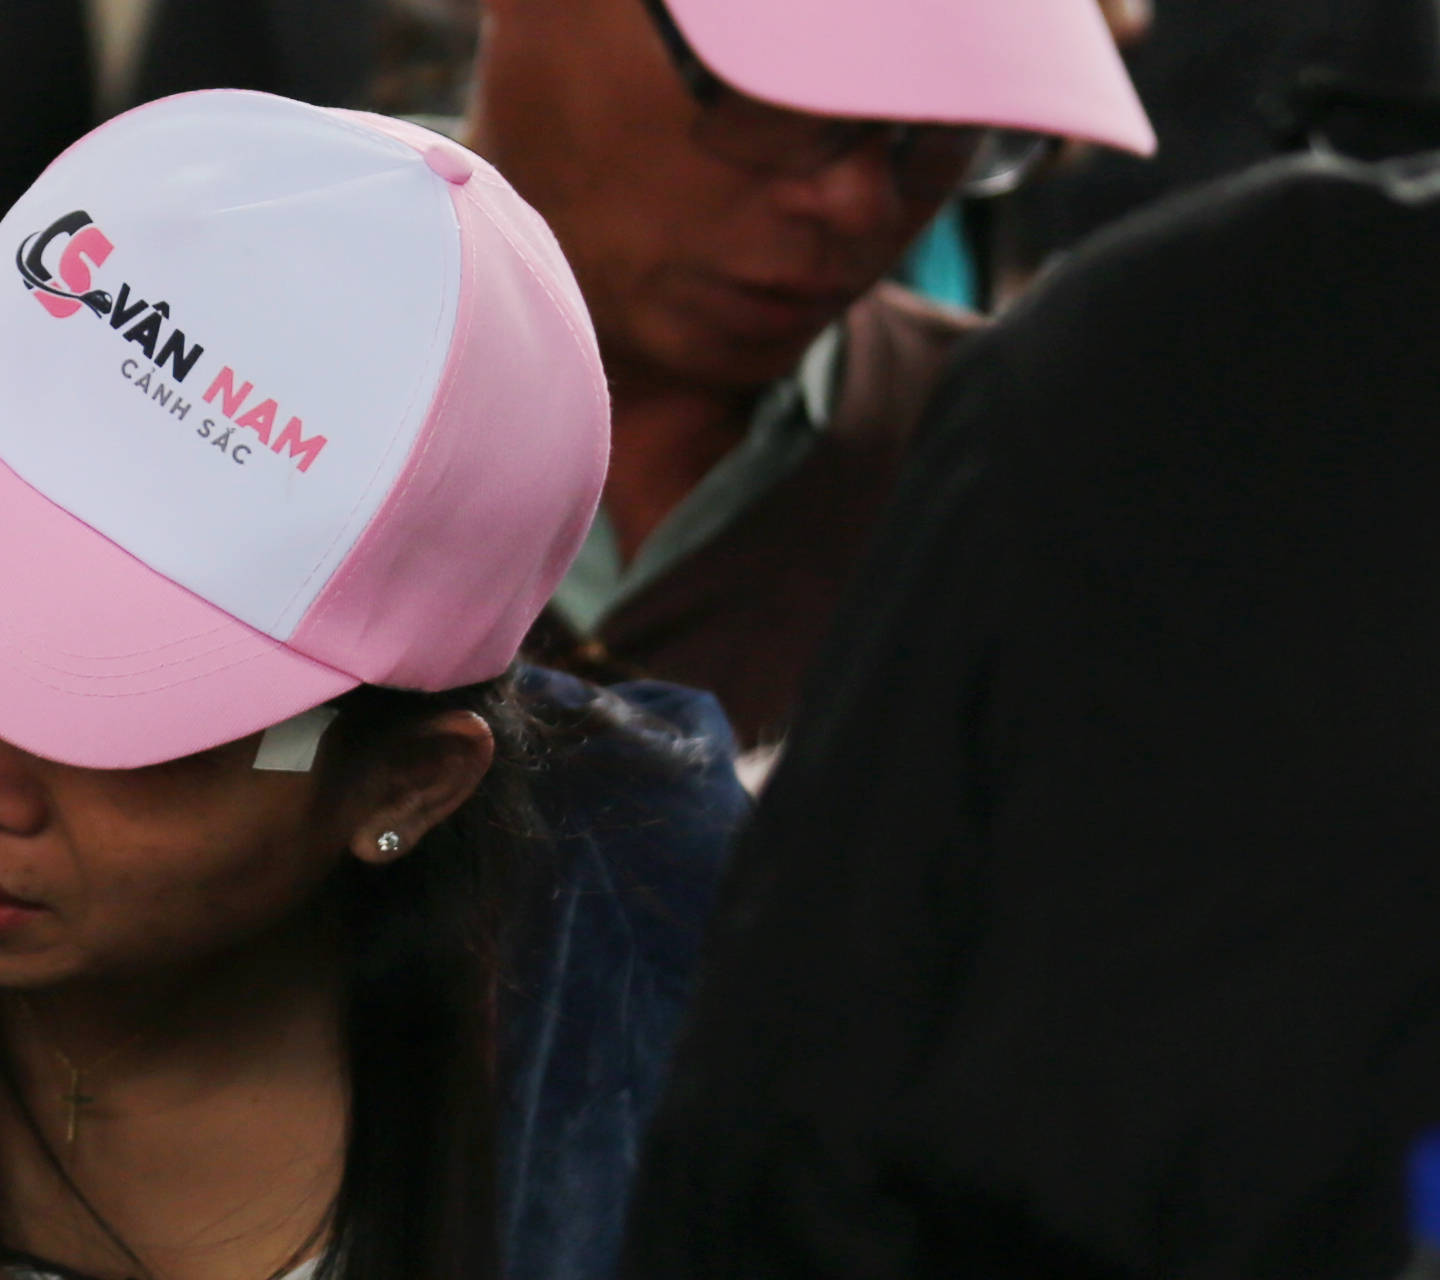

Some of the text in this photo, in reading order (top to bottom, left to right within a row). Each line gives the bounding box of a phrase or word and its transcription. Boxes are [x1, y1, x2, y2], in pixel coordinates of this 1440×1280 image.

[23, 209, 328, 473] CS VÂN NAM
